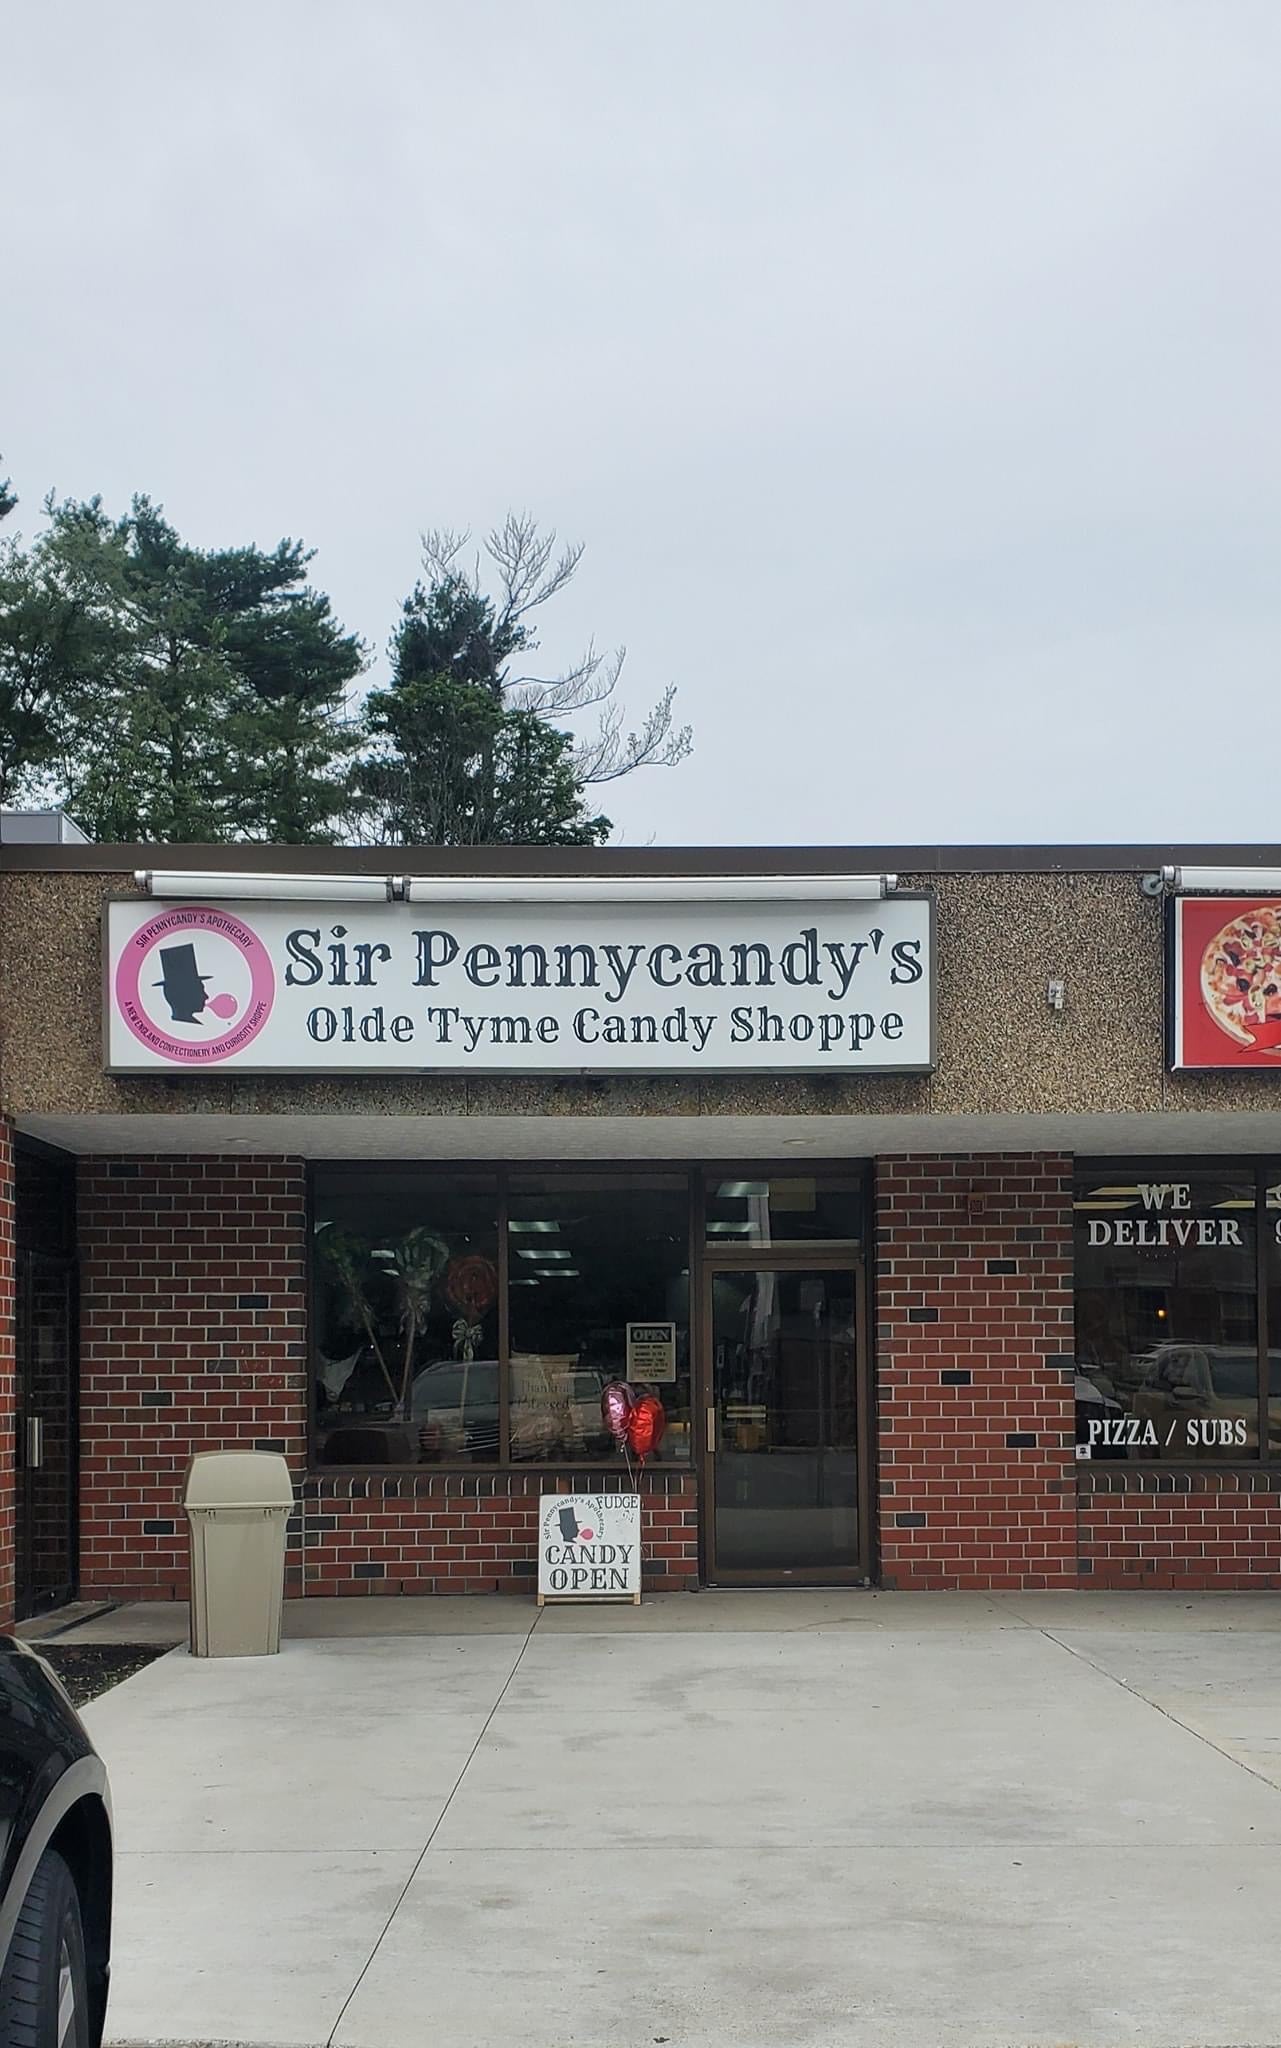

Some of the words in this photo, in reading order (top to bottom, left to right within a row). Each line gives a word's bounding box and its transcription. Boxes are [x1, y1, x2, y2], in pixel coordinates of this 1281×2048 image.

[136, 934, 150, 948] SIR
[206, 914, 254, 948] APOTHECARY
[285, 925, 392, 986] Sir
[412, 927, 923, 1001] Pennycandy's
[127, 1006, 140, 1022] NEW
[134, 1020, 161, 1046] ENGLAND
[158, 1040, 211, 1058] CONFECTIONERY
[212, 1043, 226, 1056] AND
[224, 1023, 254, 1050] CURIOSITY
[249, 1000, 267, 1028] SHOPPE
[306, 1006, 414, 1043] Olde
[427, 1006, 560, 1052] Tyme
[572, 1006, 718, 1052] Candy
[730, 1005, 904, 1051] Shoppe
[1137, 1183, 1192, 1211] WE
[1087, 1219, 1243, 1246] DELIVER
[633, 1329, 670, 1341] OPEN
[1087, 1419, 1159, 1446] PIZZA
[1186, 1419, 1248, 1446] SUBS
[595, 1495, 639, 1510] FUDGE
[543, 1528, 552, 1540] Sir
[545, 1544, 635, 1565] CANDY
[549, 1567, 630, 1590] OPEN
